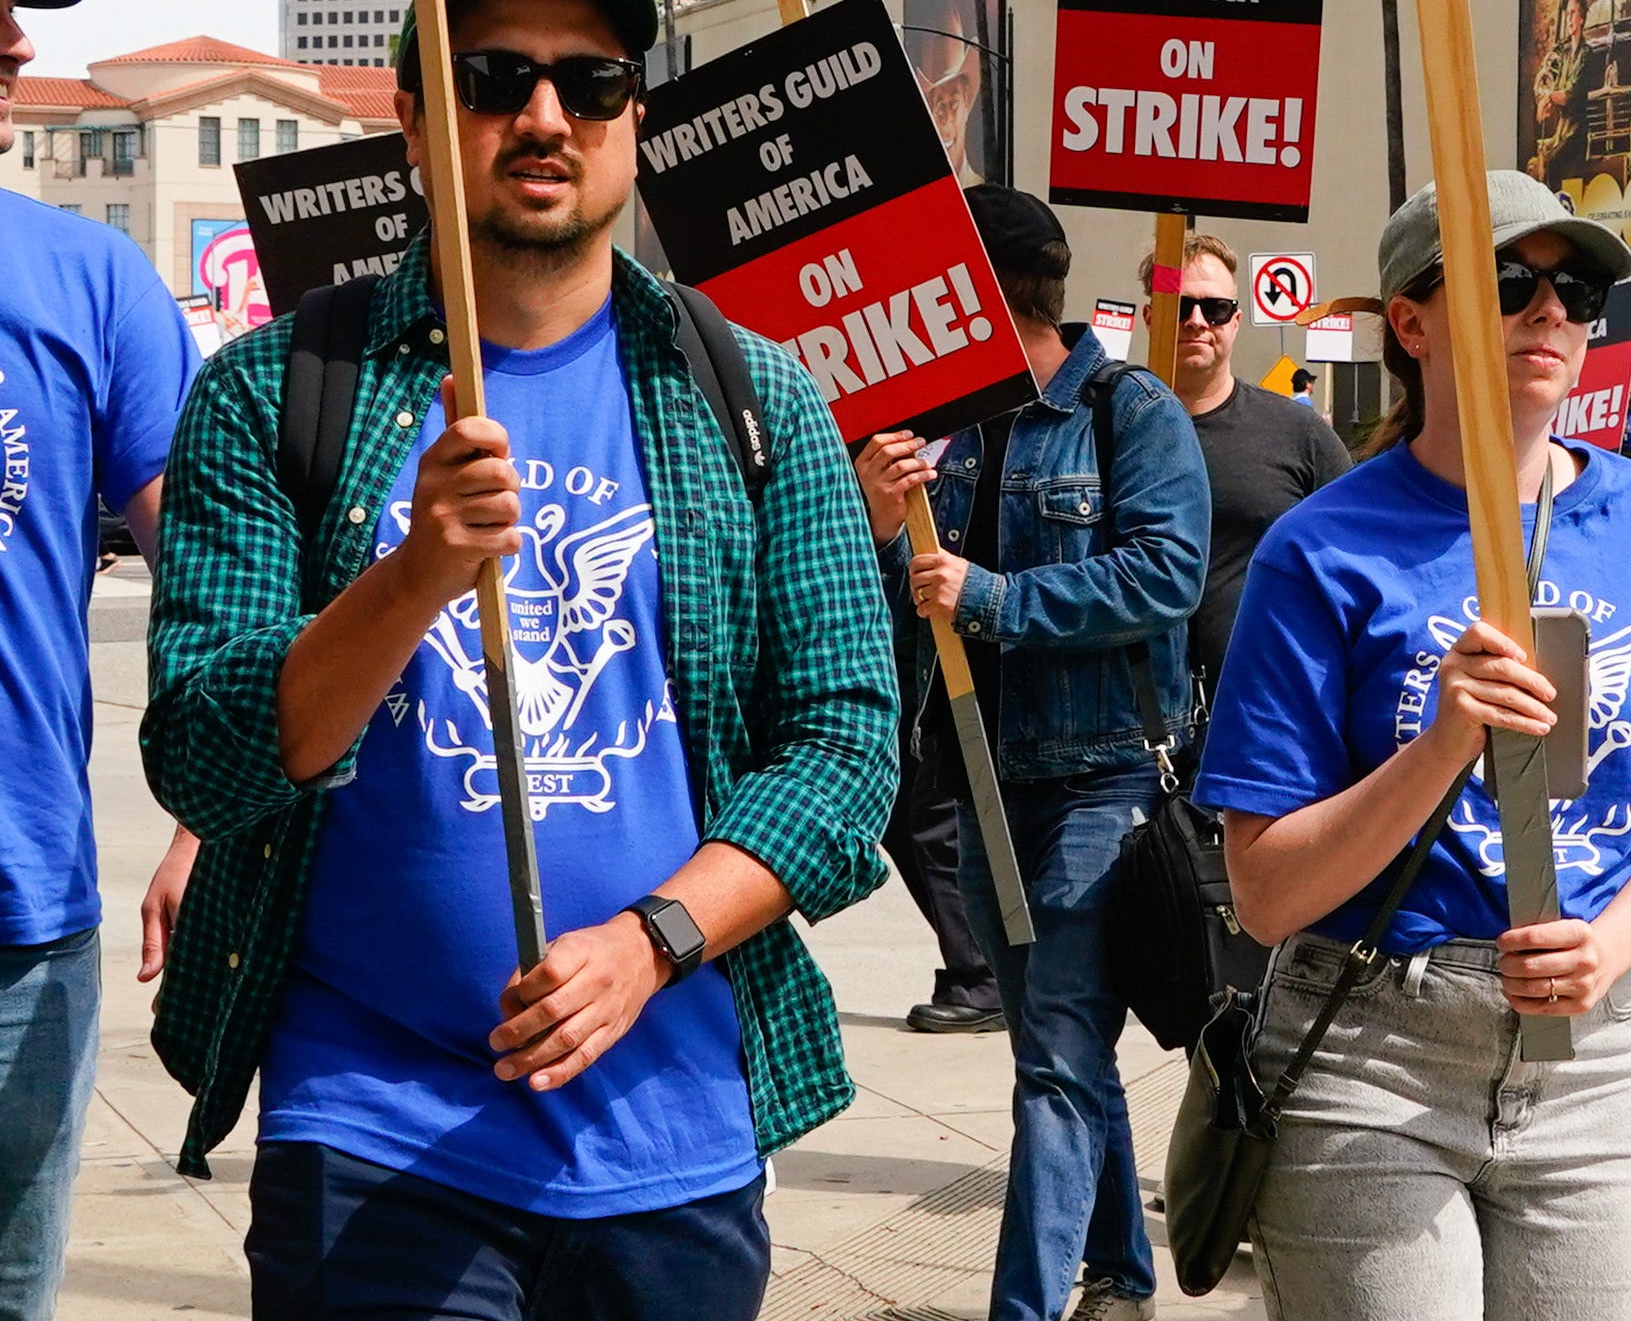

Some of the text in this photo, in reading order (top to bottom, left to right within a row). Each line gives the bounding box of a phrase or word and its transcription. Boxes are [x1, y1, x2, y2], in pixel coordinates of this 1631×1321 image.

[1160, 39, 1214, 80] ON
[640, 41, 882, 175] WRITERS GUILD
[1062, 86, 1302, 169] STRIKE!
[759, 133, 794, 172] OF
[258, 171, 406, 225] WRITERS
[726, 154, 873, 247] AMERICA
[375, 213, 408, 242] OF
[798, 248, 863, 308] ON
[788, 263, 993, 402] RIKE!
[1094, 315, 1132, 330] STRIKE!
[743, 409, 761, 451] adidas
[1554, 384, 1624, 438] IKE!
[565, 466, 620, 507] OF
[510, 600, 553, 618] united
[520, 615, 541, 630] we
[513, 627, 551, 644] stand
[1395, 649, 1442, 740] TERS
[1569, 590, 1616, 623] OF
[527, 774, 574, 795] EST
